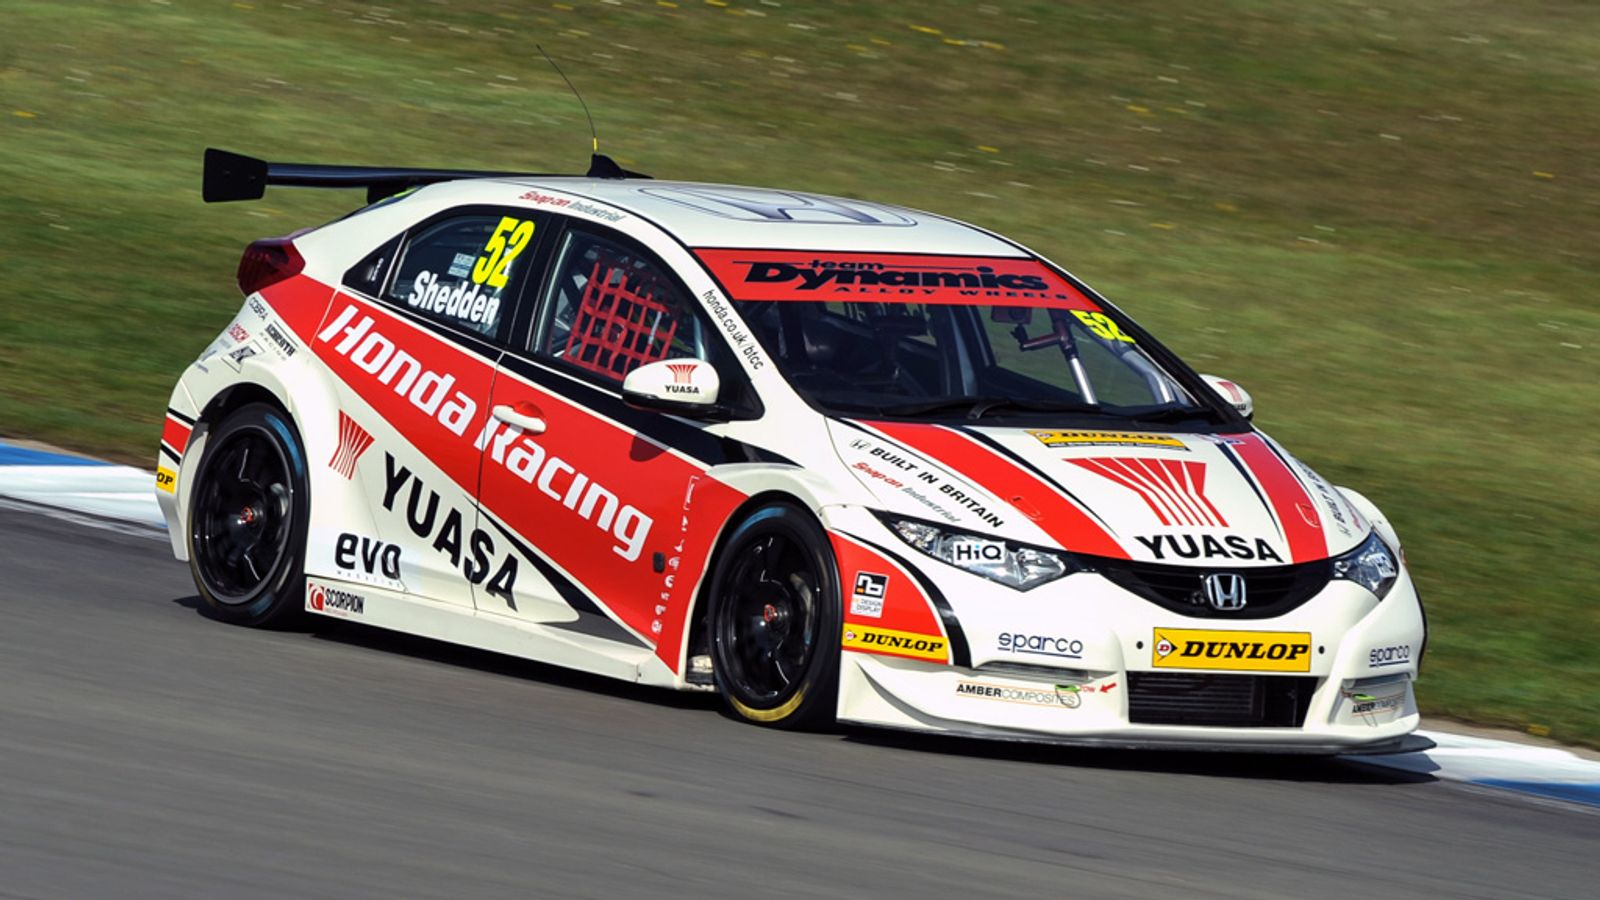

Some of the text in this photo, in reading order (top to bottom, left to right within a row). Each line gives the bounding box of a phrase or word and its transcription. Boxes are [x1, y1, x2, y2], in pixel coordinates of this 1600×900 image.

[472, 216, 535, 289] 52
[809, 259, 884, 270] team
[744, 262, 1048, 290] Dynamics
[408, 270, 501, 325] Shedden
[834, 286, 1068, 300] ALLOY WHEELS
[702, 289, 764, 370] honda.co.uk/btcc
[1069, 309, 1136, 344] 52
[664, 384, 700, 394] YUASA
[317, 304, 654, 563] Honda Racing
[1060, 431, 1175, 441] DUNLOP
[869, 446, 1005, 529] BUILT IN BRITAIN
[901, 486, 963, 523] Industrial
[382, 450, 519, 613] YUASA
[334, 532, 402, 580] evo
[956, 544, 1002, 561] HiQ
[1134, 534, 1286, 564] YUASA
[325, 587, 365, 614] SCORPION
[861, 632, 944, 652] DUNLOP
[998, 631, 1084, 655] sparco
[1180, 640, 1309, 660] DUNLOP
[1369, 645, 1409, 667] sparco
